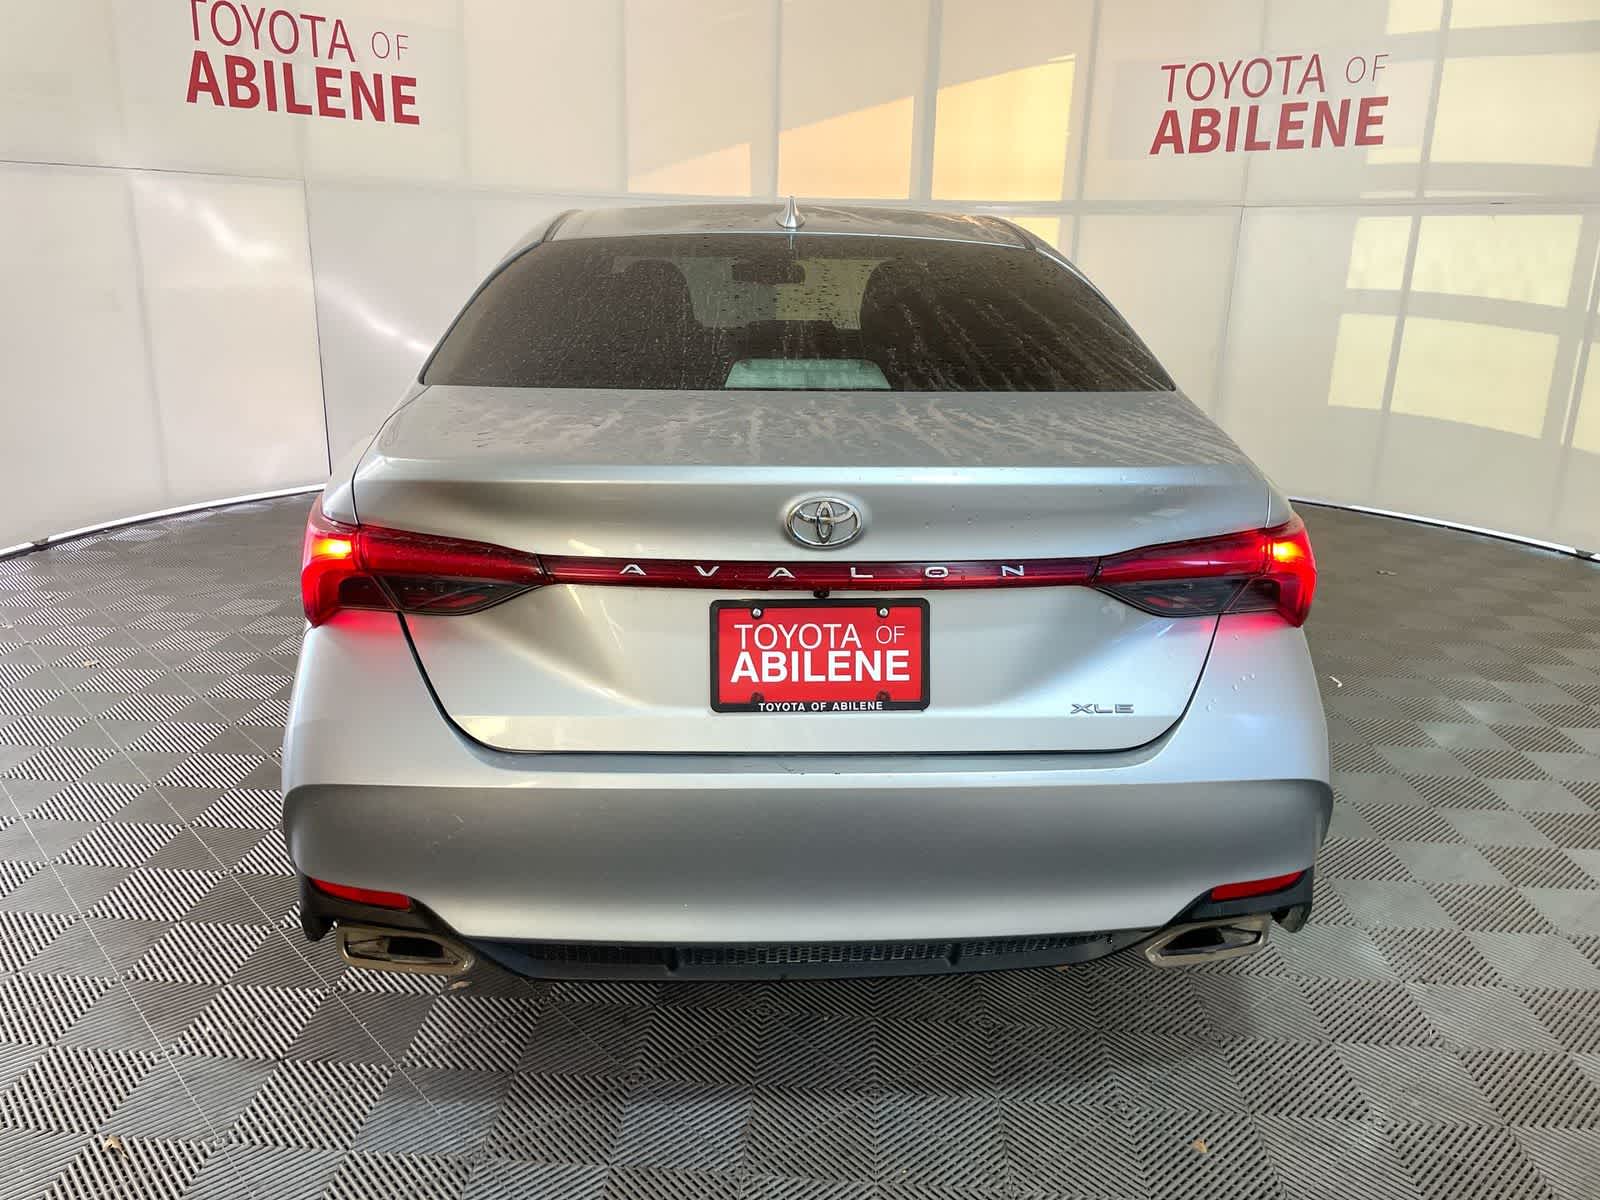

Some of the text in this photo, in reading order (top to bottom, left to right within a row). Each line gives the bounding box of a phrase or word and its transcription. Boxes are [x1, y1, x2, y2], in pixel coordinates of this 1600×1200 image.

[190, 0, 409, 62] TOYOTA OF
[186, 50, 420, 125] ABILENE
[1160, 53, 1389, 103] TOYOTA OF
[1149, 96, 1389, 155] ABILENE
[619, 564, 1025, 579] AVALON
[734, 624, 905, 649] TOYOTA OF
[730, 650, 910, 683] ABILENE
[758, 701, 883, 712] TOYOTA OF ABILENE
[1070, 703, 1134, 714] XLE
